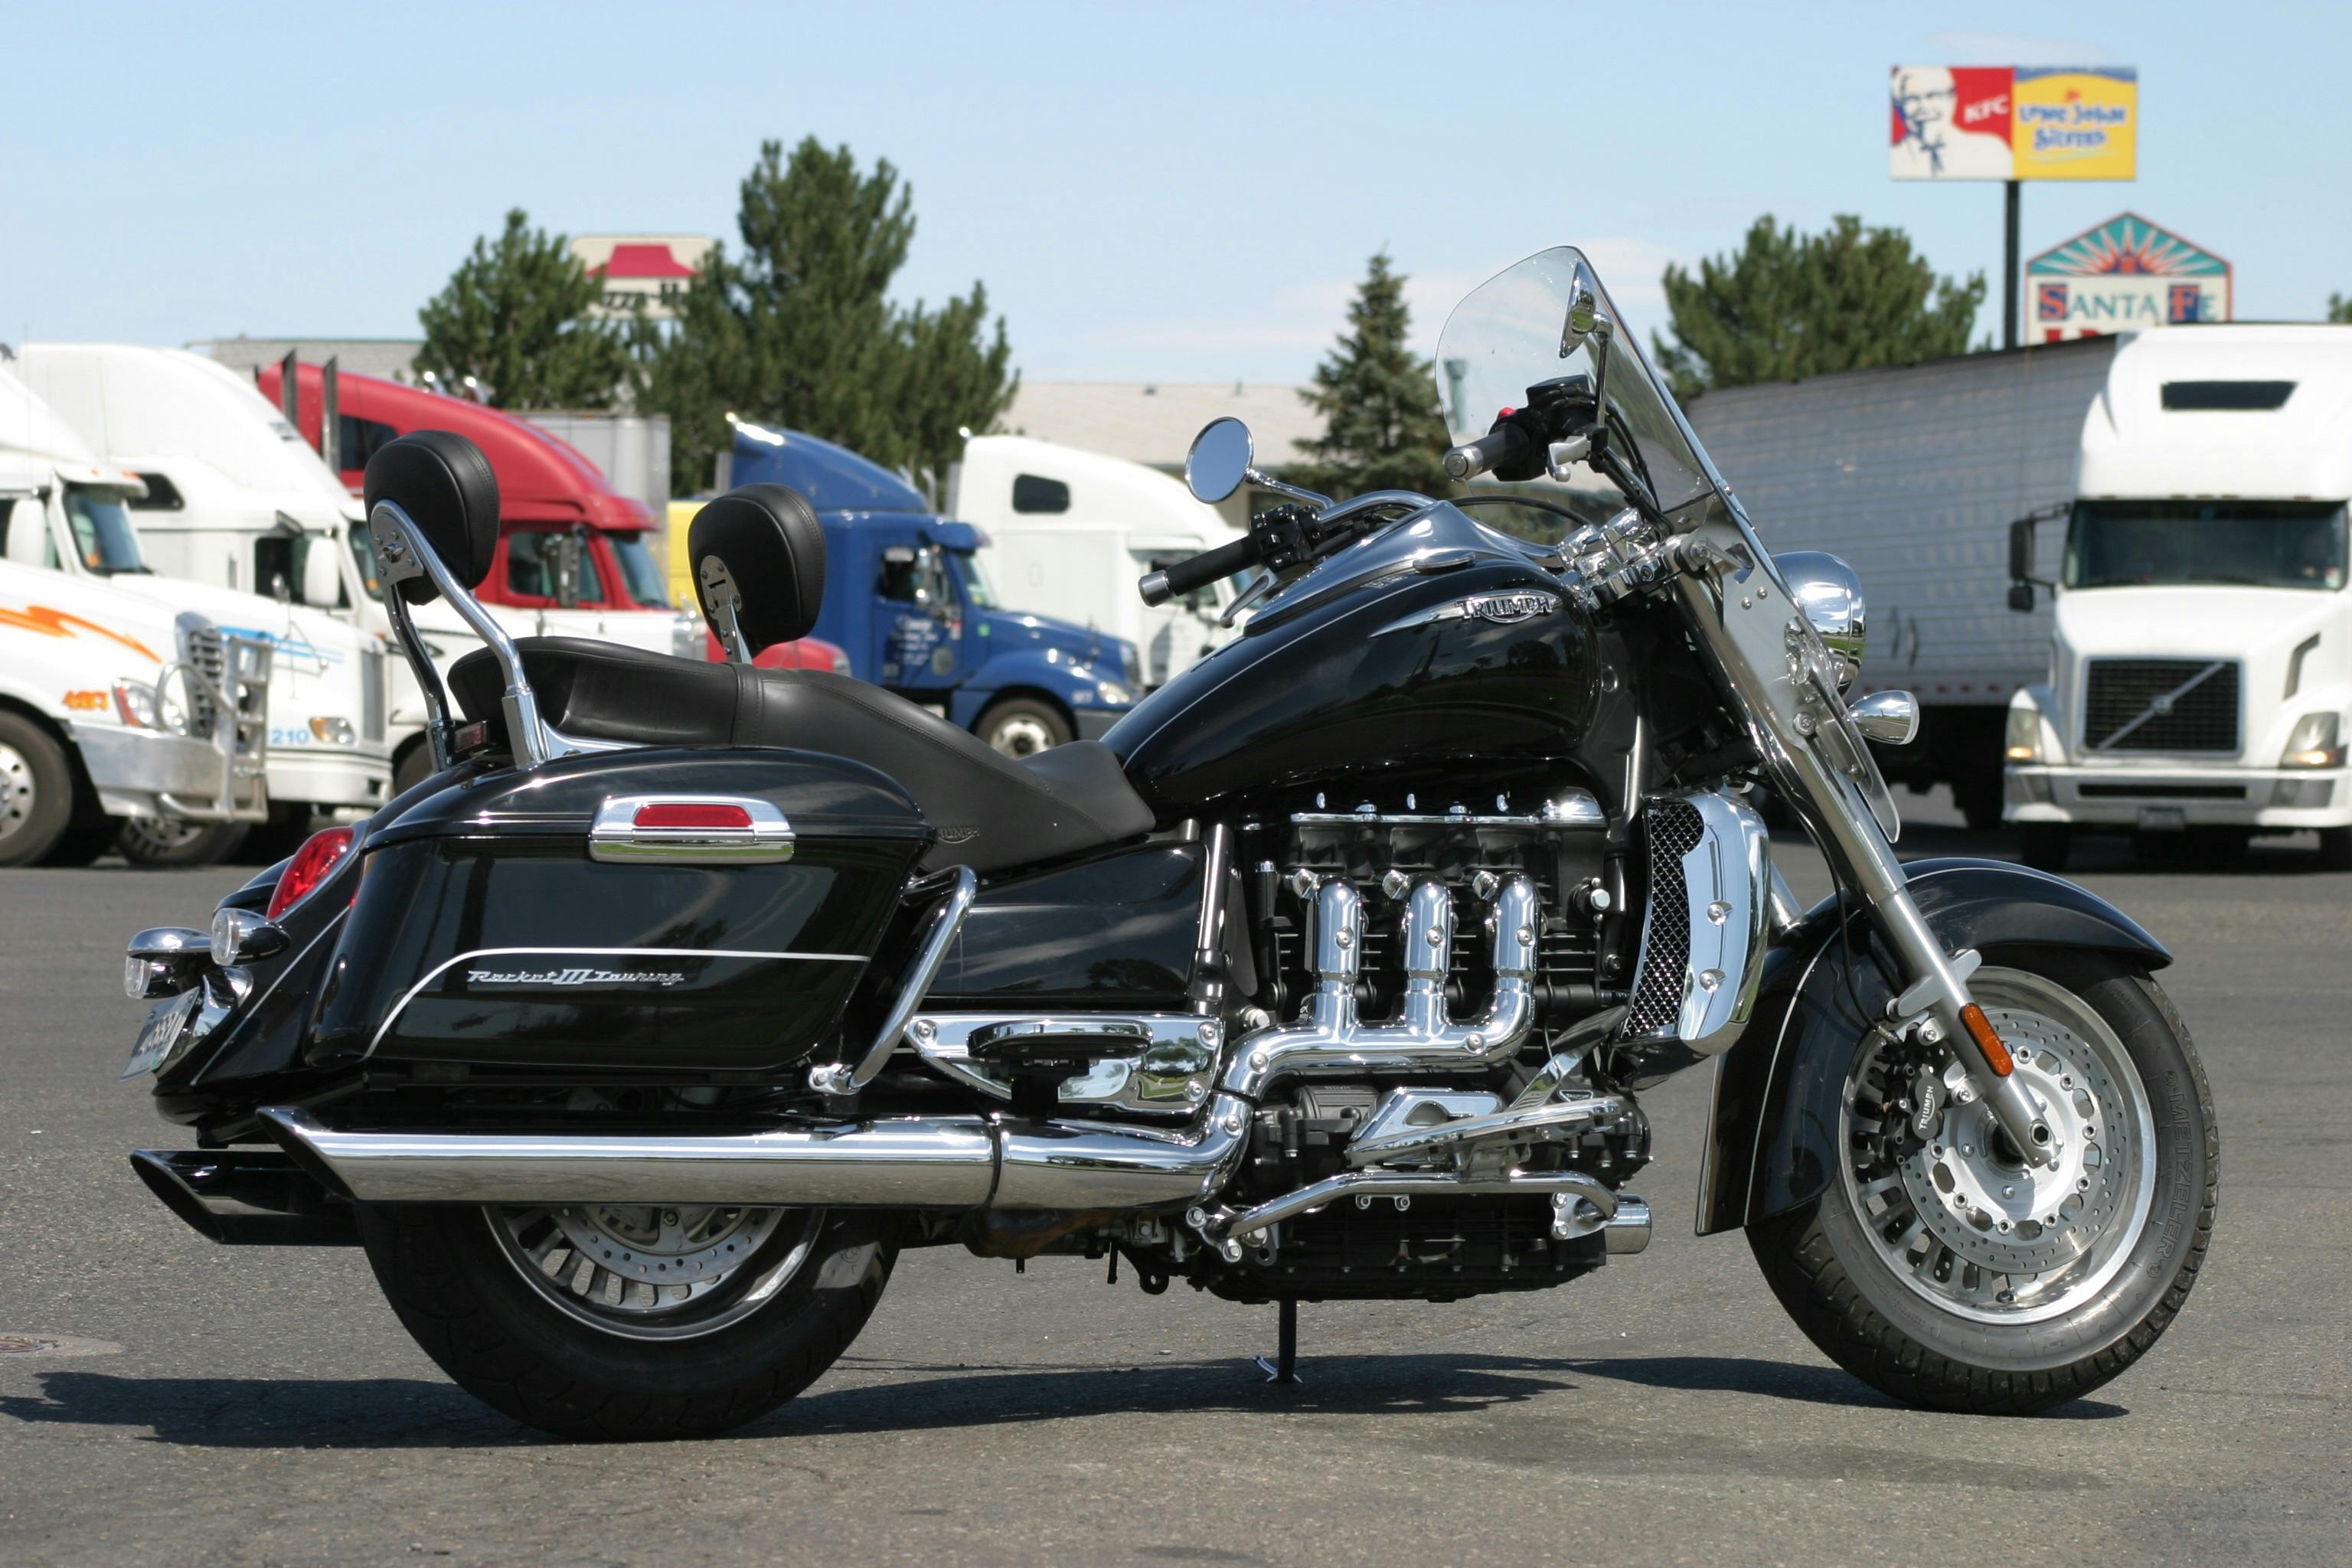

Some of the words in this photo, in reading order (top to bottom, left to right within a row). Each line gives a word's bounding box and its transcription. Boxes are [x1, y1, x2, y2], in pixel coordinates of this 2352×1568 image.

[1963, 94, 2010, 123] KFC
[2040, 284, 2161, 320] SANTA
[2171, 286, 2217, 322] FE
[1457, 596, 1553, 622] TRIUMPH
[270, 728, 310, 744] 210
[467, 970, 557, 982] Rocket
[1918, 1085, 1936, 1130] TRIUMPH
[2155, 1093, 2194, 1259] METZELER
